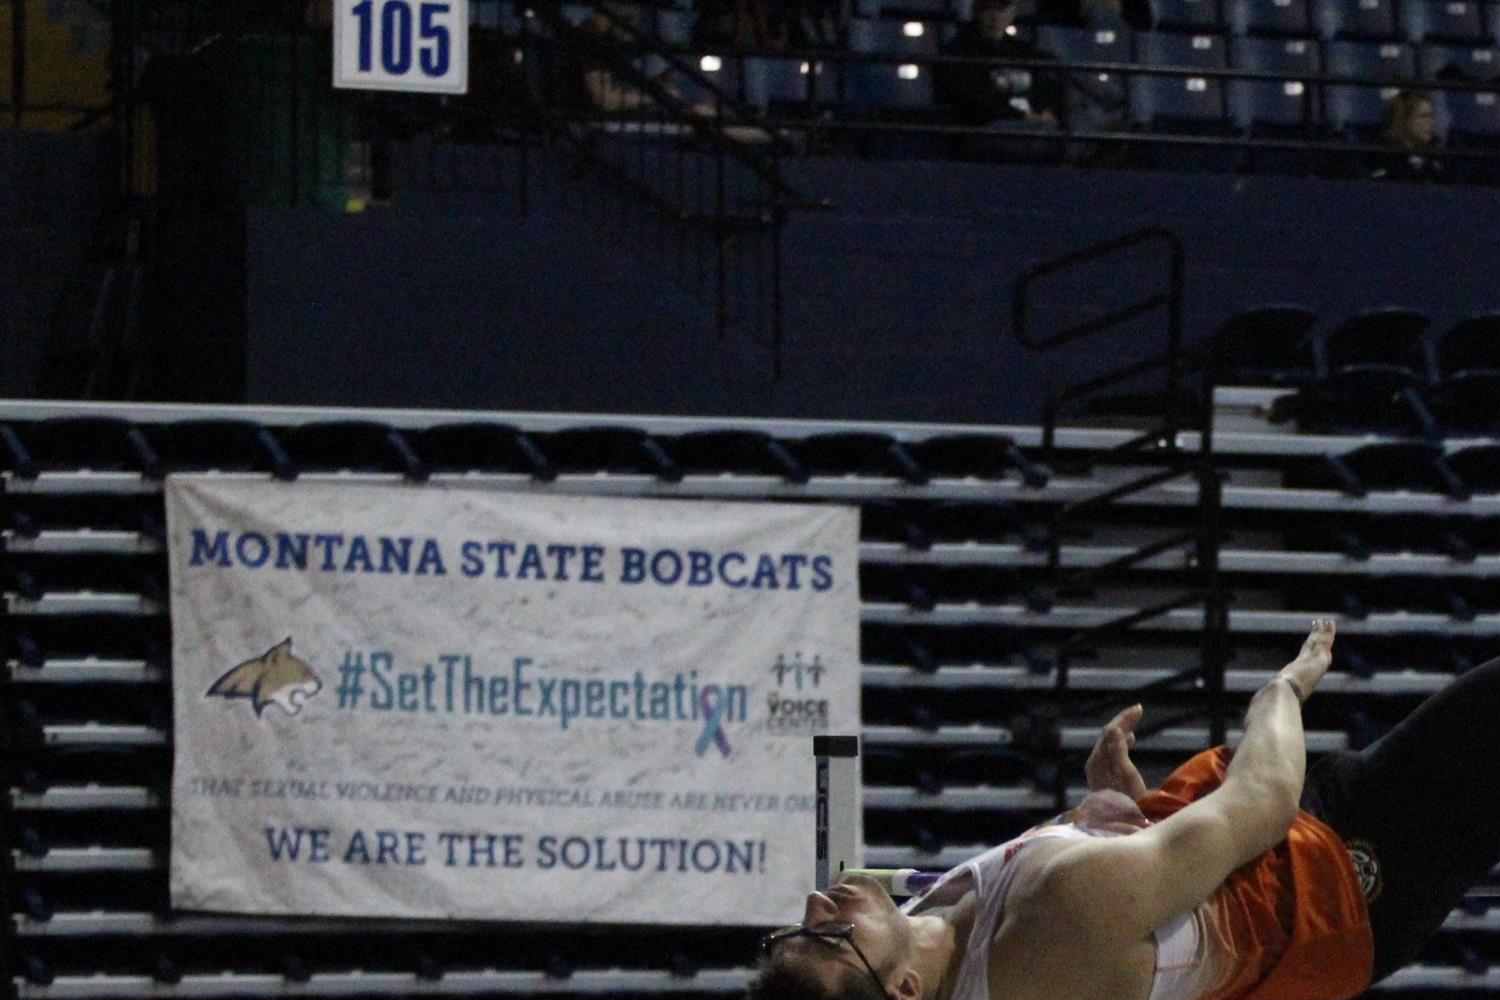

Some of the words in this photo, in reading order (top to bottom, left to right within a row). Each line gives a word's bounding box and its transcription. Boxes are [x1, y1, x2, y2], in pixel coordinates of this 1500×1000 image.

[351, 0, 450, 77] 105
[189, 528, 448, 576] MONTANA
[460, 540, 606, 583] STATE
[619, 546, 834, 592] BOBCATS
[264, 826, 331, 864] WE
[342, 828, 427, 867] ARE
[437, 830, 525, 869] THE
[535, 834, 768, 875] SOLUTION!
